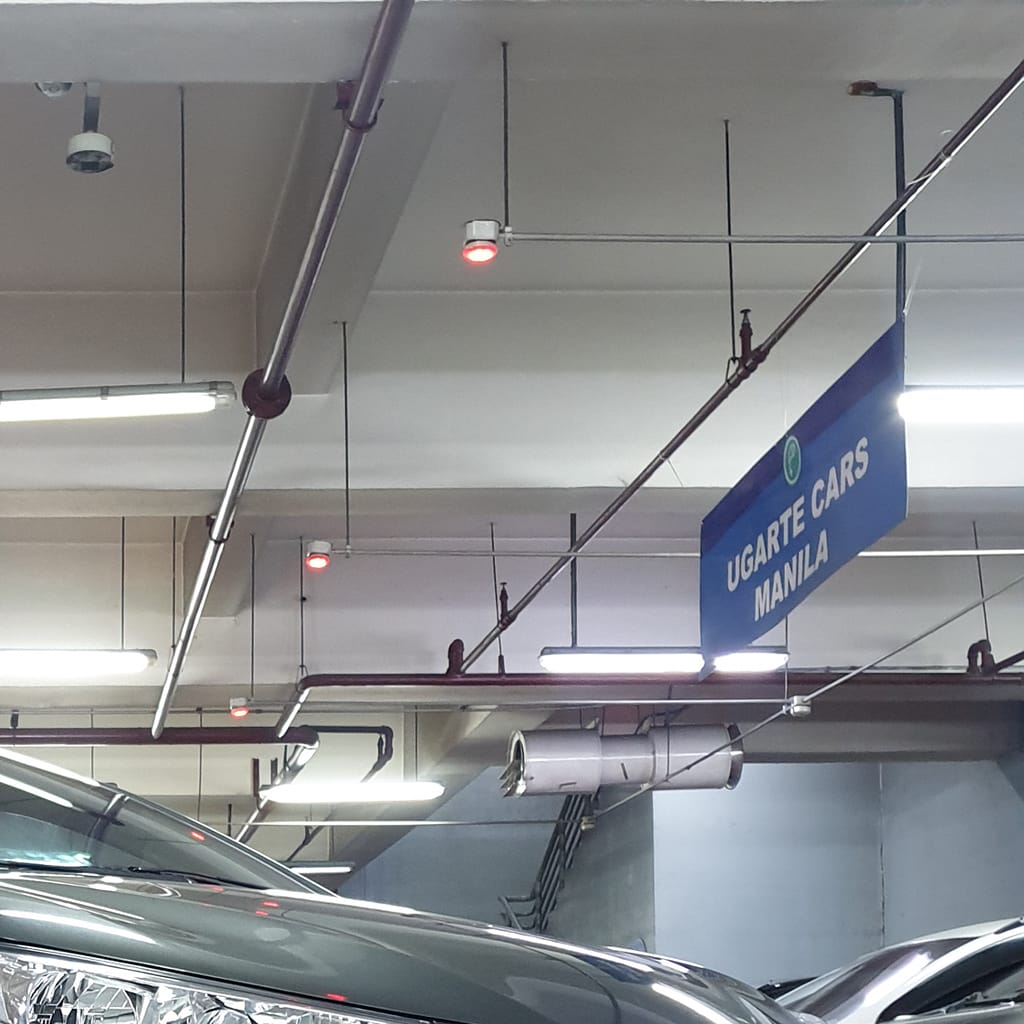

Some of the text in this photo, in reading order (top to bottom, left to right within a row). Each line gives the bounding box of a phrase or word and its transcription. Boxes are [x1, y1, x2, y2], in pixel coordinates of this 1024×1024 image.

[727, 436, 869, 592] UGARTE CARS
[755, 529, 828, 621] MANILA
